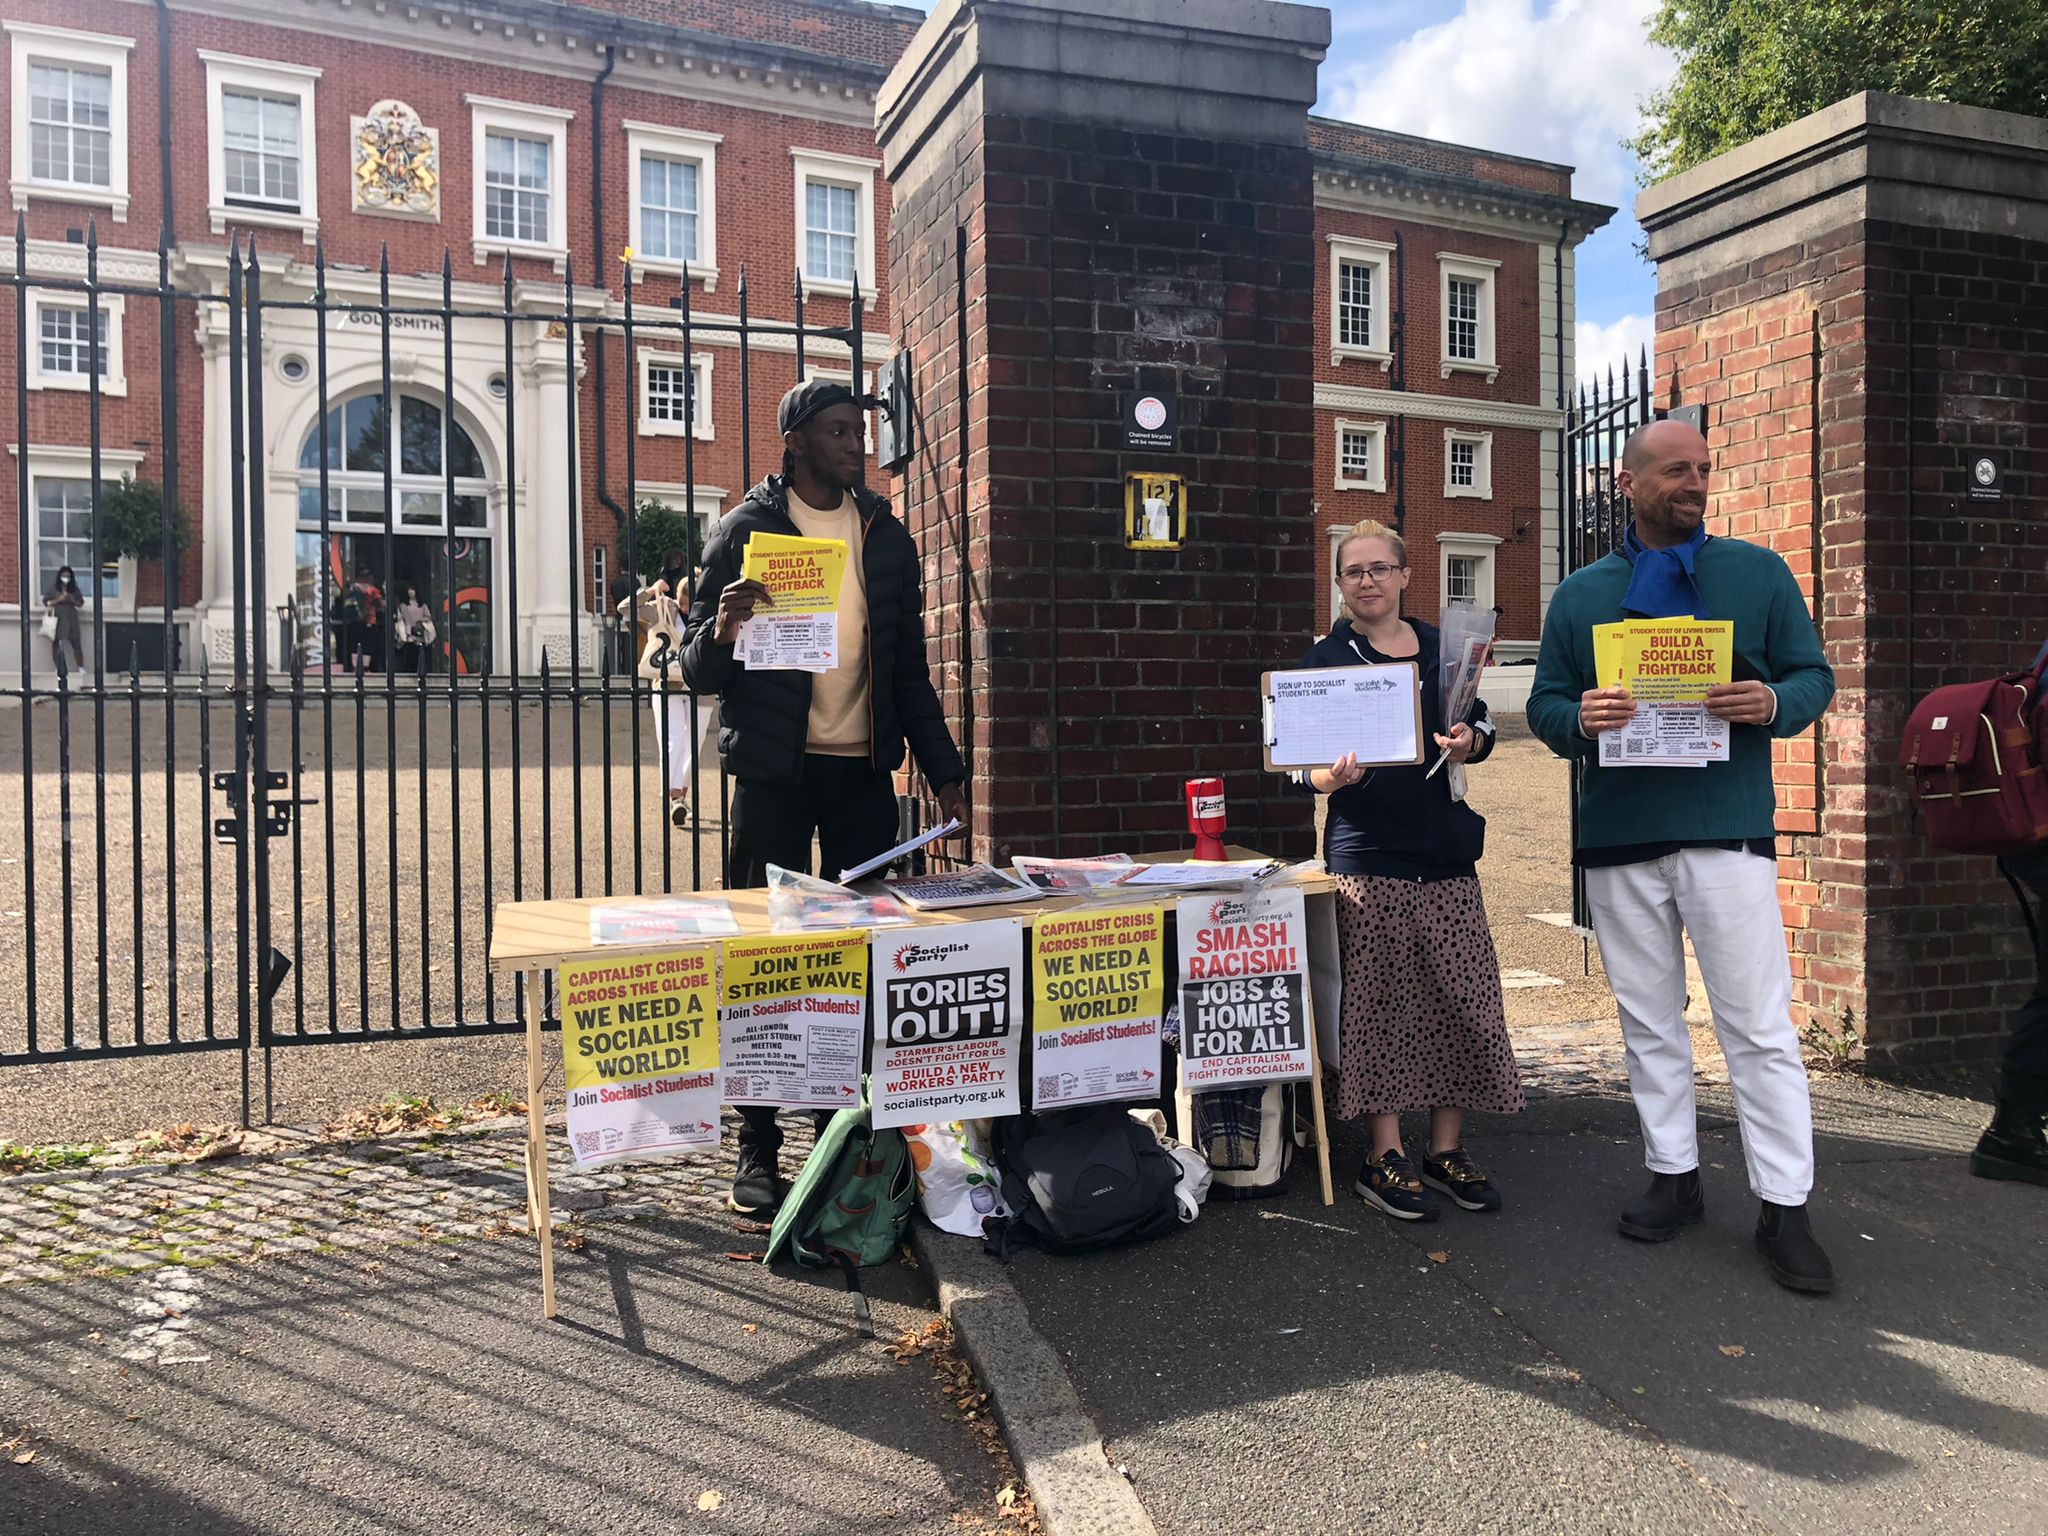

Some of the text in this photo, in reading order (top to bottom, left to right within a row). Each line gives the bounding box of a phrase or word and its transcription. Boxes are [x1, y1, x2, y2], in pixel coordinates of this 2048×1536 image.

[1129, 431, 1150, 439] Chained
[761, 568, 823, 582] SOCIALIST
[769, 557, 815, 570] BUILD A
[766, 579, 825, 593] IGHTBACK
[1650, 636, 1704, 648] BUILD A
[1641, 650, 1714, 661] SOCIALIST
[1638, 663, 1716, 675] FIGHTBACK
[1277, 682, 1292, 690] SIGN
[1294, 681, 1301, 689] UP
[1313, 679, 1346, 687] SOCIALIST
[1278, 688, 1327, 698] STUDENTS HERE
[1040, 913, 1155, 937] CAPITALIST CRISIS
[729, 935, 865, 958] STUDENT COST OF LIVING CRISIS
[1038, 928, 1158, 954] ACROSS THE GLOBE
[1196, 922, 1288, 953] SMASH
[910, 943, 970, 956] Socialist
[569, 956, 704, 987] CAPITALIST CRISIS
[750, 952, 843, 976] JOIN THE
[1044, 947, 1150, 977] WE NEED A
[1189, 947, 1297, 980] RACISM!
[568, 973, 709, 1006] ACROSS THE GLOBE
[728, 971, 862, 1000] STRIKE WAVE
[889, 973, 1006, 1009] TORIES
[1046, 970, 1151, 1001] SOCIALIST
[1197, 976, 1290, 1006] JOBS &
[574, 994, 703, 1031] WE NEED A
[726, 998, 860, 1021] Join Socialist Students!
[1060, 995, 1138, 1022] WORLD!
[1198, 1000, 1291, 1031] HOMES
[746, 1023, 789, 1033] ALL-LONDON
[891, 1001, 1005, 1044] OUT!
[578, 1018, 704, 1057] SOCIALIST
[731, 1033, 769, 1044] SOCIALIST
[770, 1032, 802, 1042] STUDENT
[751, 1042, 782, 1050] MEETING
[1038, 1020, 1156, 1050] Join Socialist Students!
[1193, 1026, 1299, 1057] FOR ALL
[886, 1048, 1006, 1068] DOESN'T FIGHT FOR US
[895, 1041, 998, 1058] STARMER'S LABOUR
[1202, 1053, 1291, 1068] END CAPITALISM
[596, 1046, 690, 1079] WORLD!
[902, 1061, 990, 1080] BUILD A NEW
[1188, 1063, 1304, 1080] FIGHT FOR SOCIALISM
[572, 1073, 714, 1108] Join Socialist Students!
[886, 1070, 1005, 1092] WORKERS' PARTY
[884, 1088, 1006, 1111] socialistparty.org.uk
